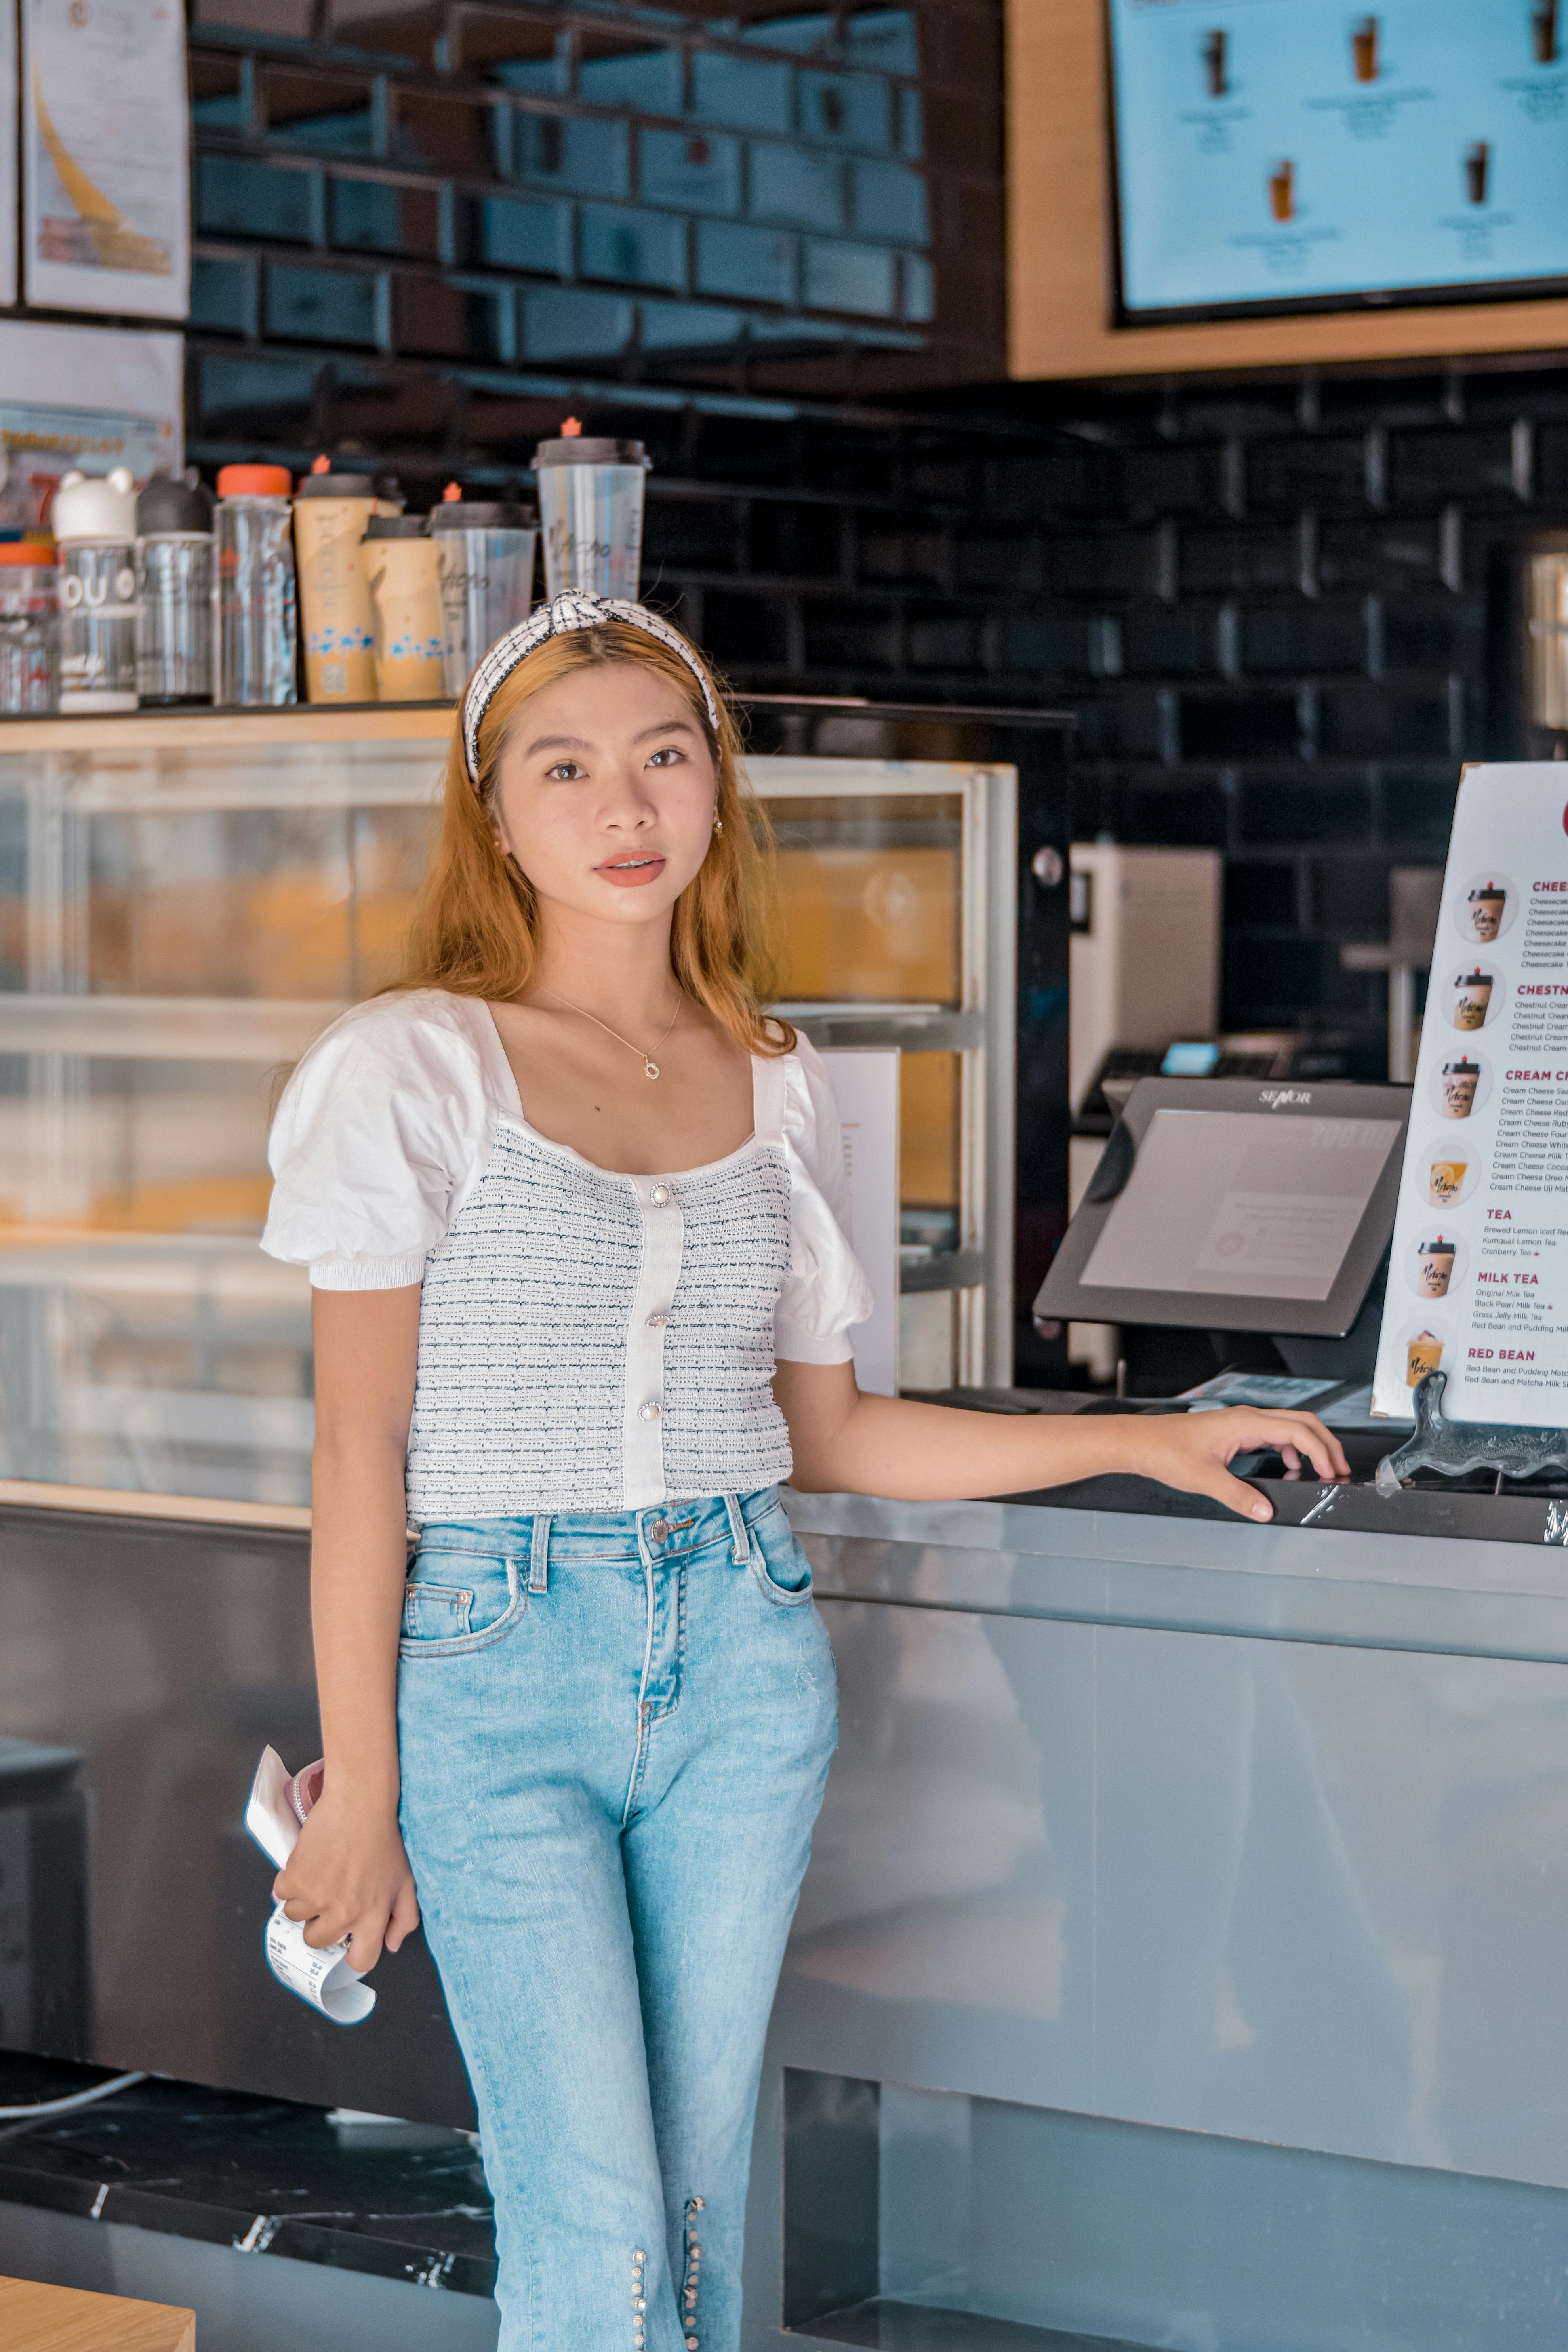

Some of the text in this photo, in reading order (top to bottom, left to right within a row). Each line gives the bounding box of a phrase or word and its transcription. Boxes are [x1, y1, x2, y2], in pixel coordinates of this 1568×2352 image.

[1532, 881, 1568, 891] CHEE
[1517, 985, 1568, 995] CHESTN
[1505, 1070, 1551, 1080] CREAM
[1259, 1089, 1311, 1110] SENOR
[1552, 1120, 1568, 1128] Ruby
[1543, 1185, 1553, 1193] Uji
[1487, 1209, 1511, 1219] TEA
[1481, 1248, 1516, 1256] Cranberry
[1477, 1272, 1538, 1284] MILK TEA
[1476, 1289, 1504, 1297] Original
[1524, 1324, 1553, 1333] Pudding
[1468, 1348, 1535, 1360] RED BEAN
[1518, 1368, 1548, 1377] Pudding
